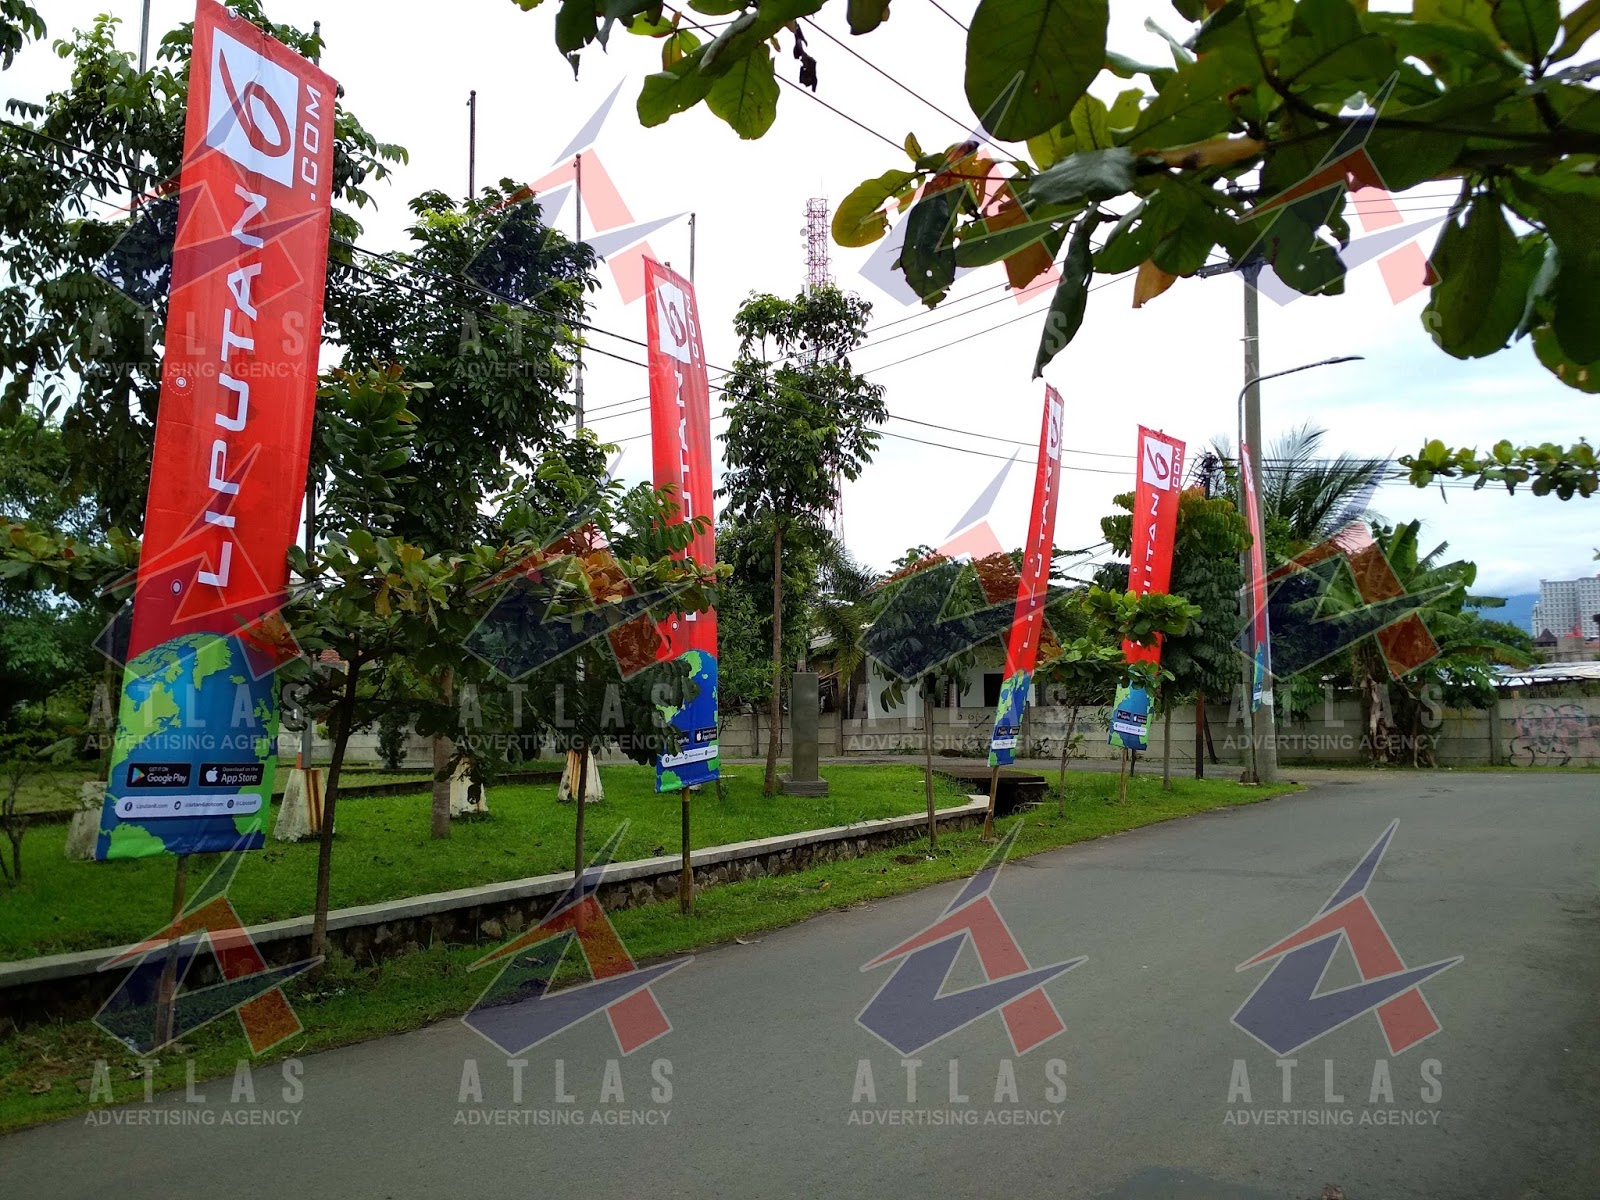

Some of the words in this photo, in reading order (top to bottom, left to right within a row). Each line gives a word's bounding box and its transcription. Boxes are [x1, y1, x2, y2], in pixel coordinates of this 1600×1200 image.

[301, 84, 322, 202] .COM
[197, 183, 267, 588] LIPUTAN
[1172, 447, 1182, 494] .COM
[147, 772, 172, 785] Google
[173, 772, 187, 784] Play
[220, 773, 238, 785] App
[238, 773, 258, 782] Store
